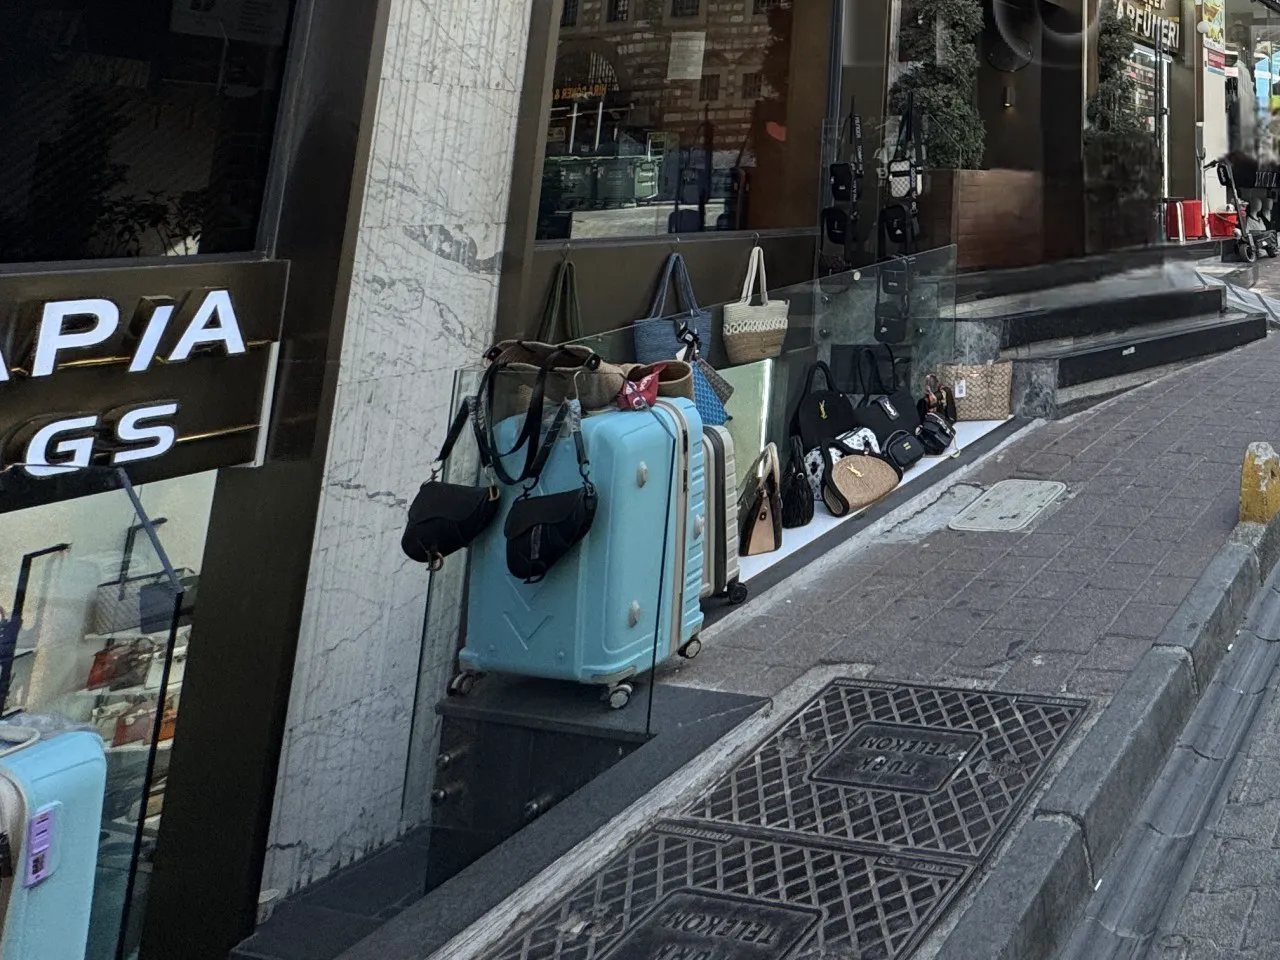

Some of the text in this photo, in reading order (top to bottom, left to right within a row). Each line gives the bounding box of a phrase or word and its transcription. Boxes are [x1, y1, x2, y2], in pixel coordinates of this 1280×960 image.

[0, 290, 247, 382] PIA
[858, 736, 955, 757] TELEKOM
[658, 910, 781, 946] TELEKOM
